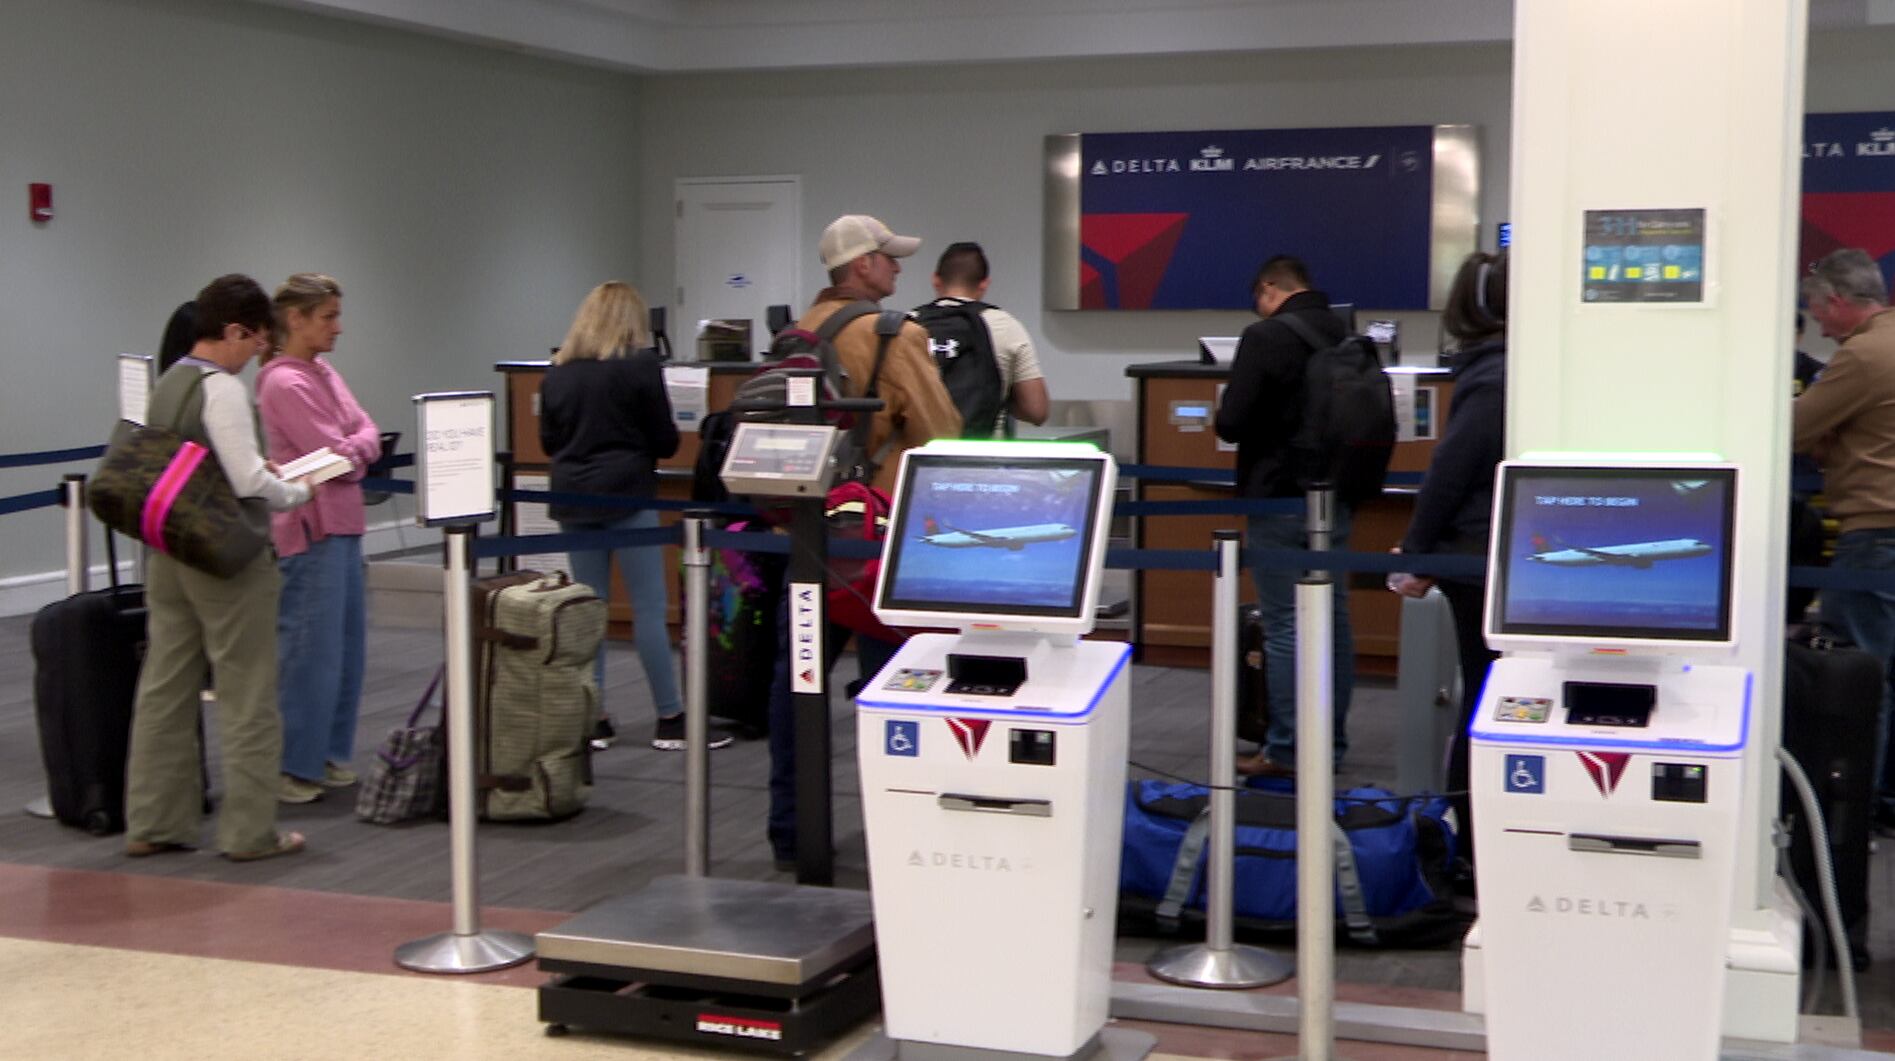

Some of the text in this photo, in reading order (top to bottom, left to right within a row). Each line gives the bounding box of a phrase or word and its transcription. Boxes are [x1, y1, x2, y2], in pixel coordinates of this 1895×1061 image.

[1111, 155, 1363, 174] DELTA KLM AIRFRANCE
[1558, 496, 1586, 506] HERE
[1587, 496, 1606, 506] TO
[1606, 497, 1640, 507] BEGIN
[799, 590, 814, 661] DELTA
[932, 852, 1012, 872] DELTA
[1556, 896, 1650, 919] DELTA
